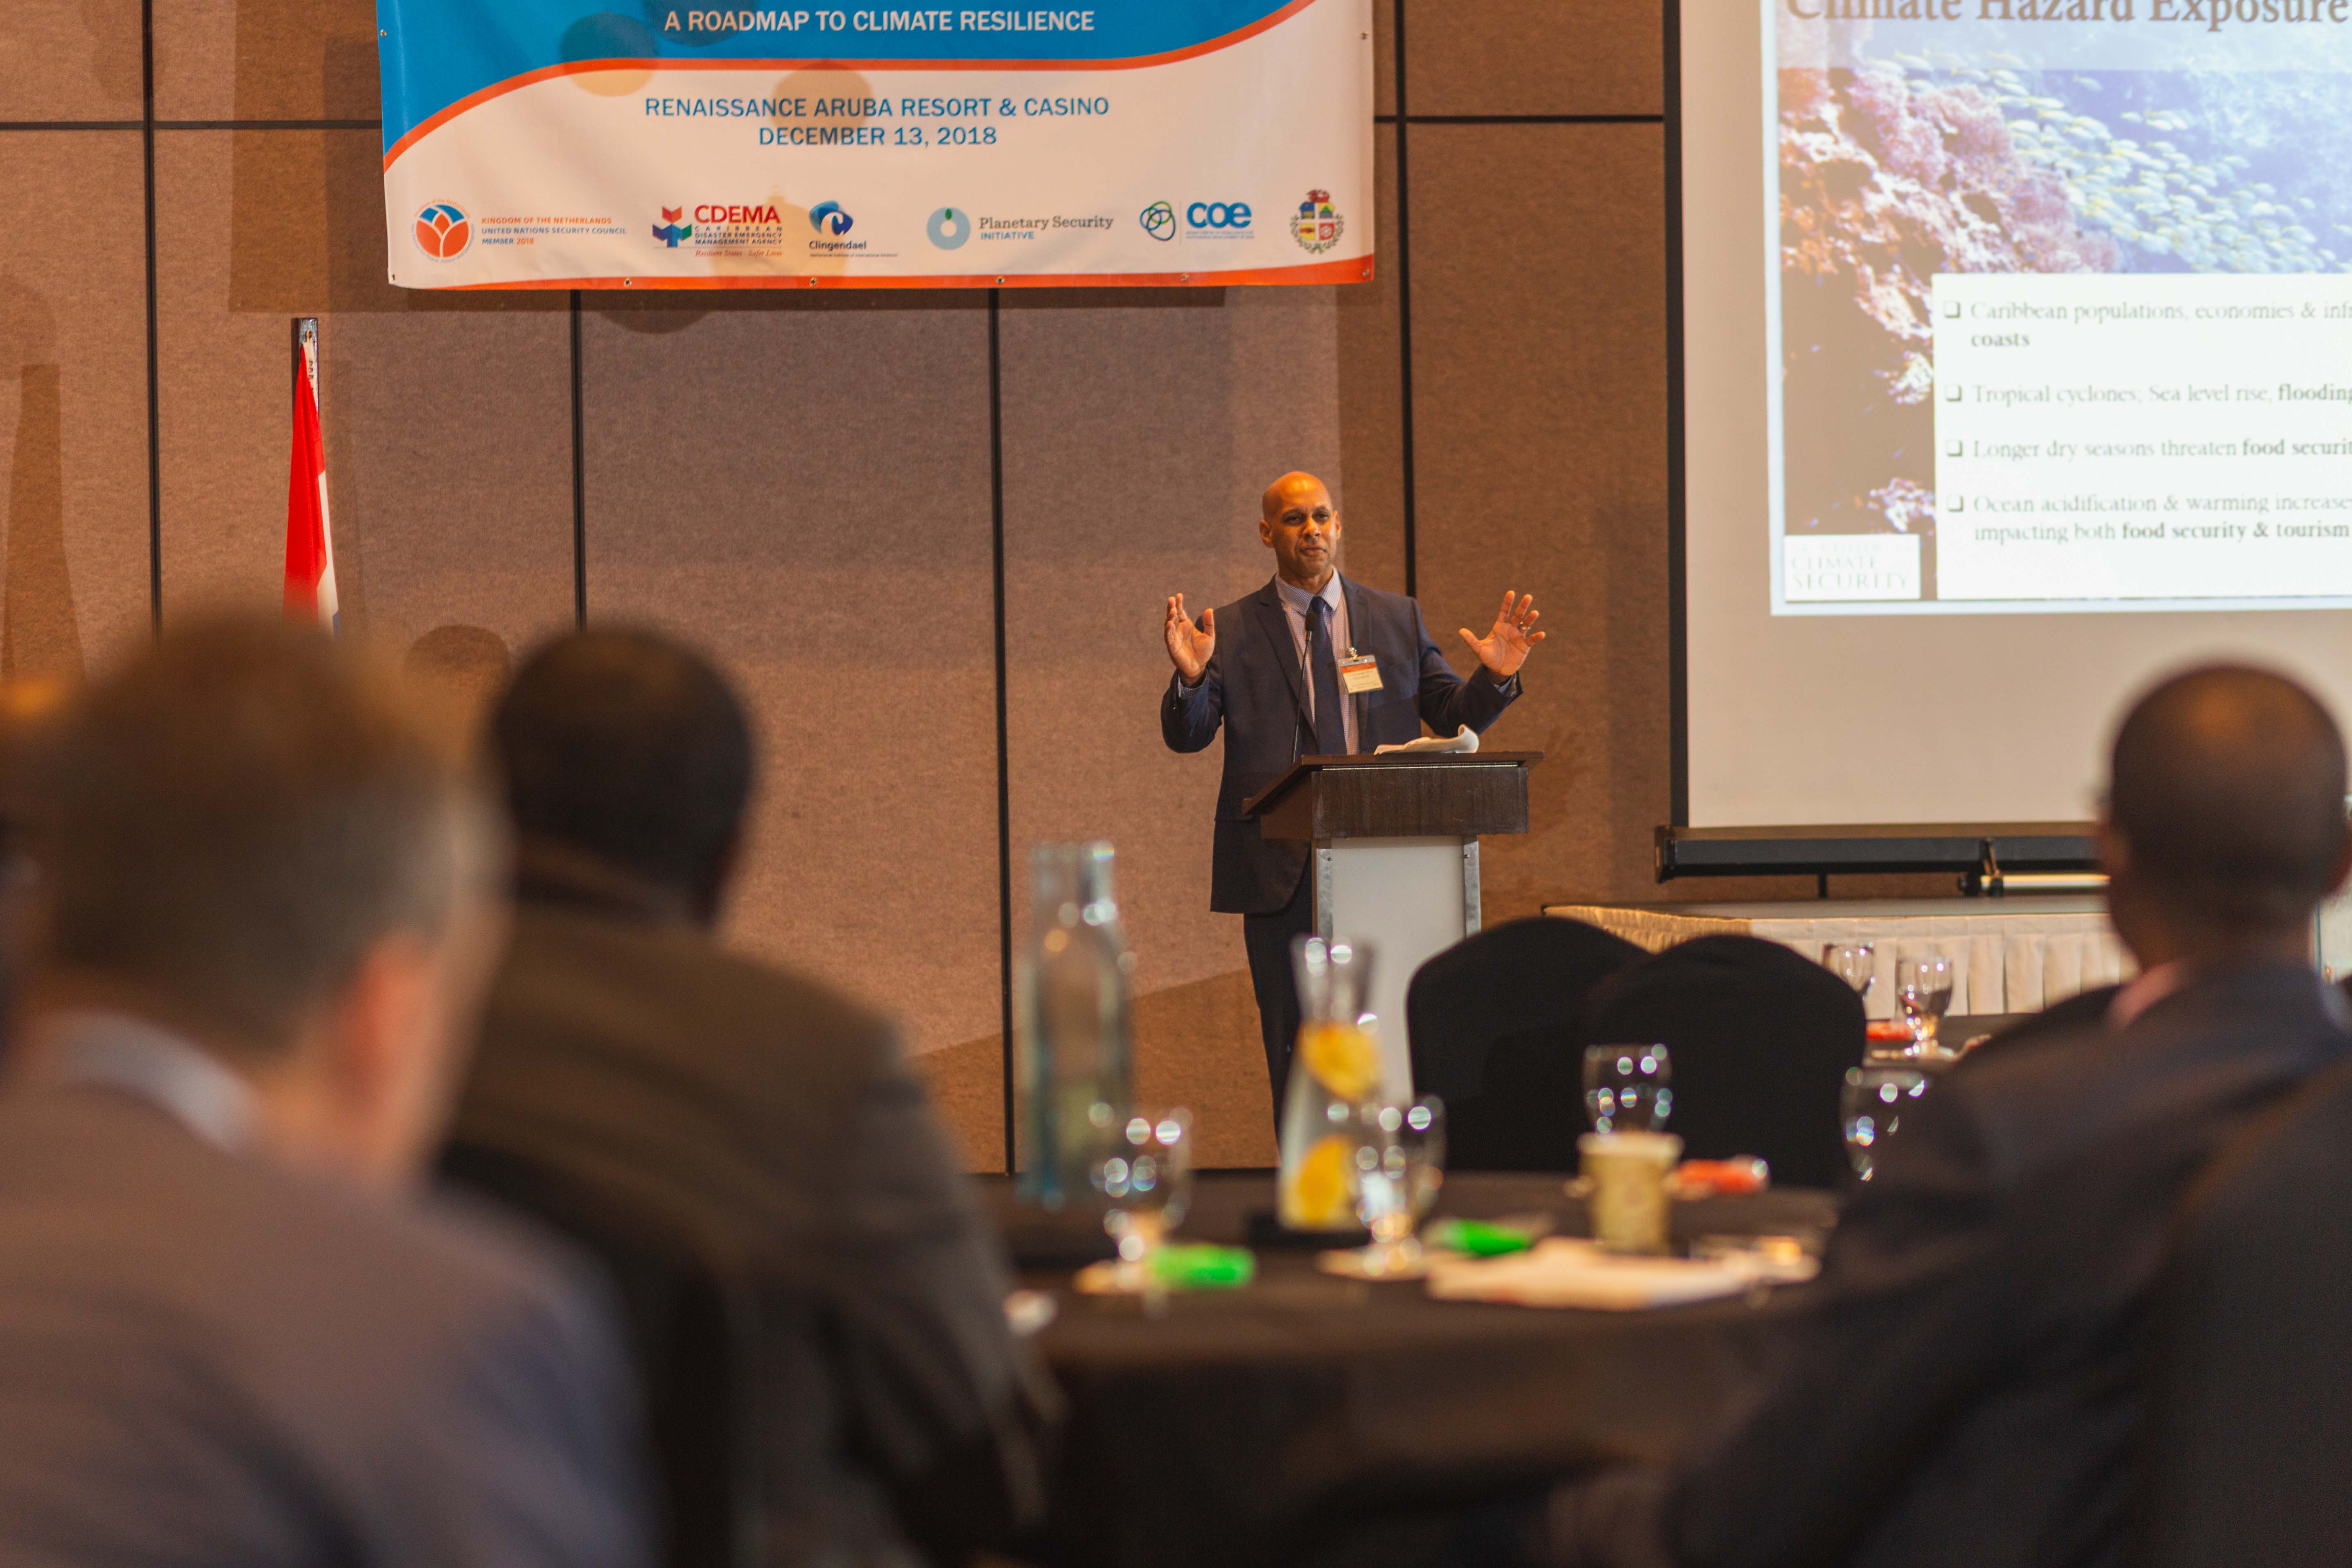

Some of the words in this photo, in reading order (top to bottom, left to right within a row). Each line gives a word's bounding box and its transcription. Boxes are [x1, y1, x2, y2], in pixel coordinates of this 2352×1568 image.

[664, 11, 681, 31] A
[688, 11, 810, 31] ROADMAP
[815, 11, 846, 31] TO
[853, 11, 953, 31] CLIMATE
[960, 11, 1095, 31] RESILIENCE
[1788, 0, 1962, 20] Climate
[1976, 0, 2135, 21] Hazard
[2149, 0, 2349, 32] Exposure
[646, 98, 807, 117] RENAISSANCE
[814, 98, 893, 117] ARUBA
[901, 98, 991, 117] RESORT
[999, 98, 1017, 117] &
[1024, 97, 1109, 116] CASINO
[759, 127, 885, 145] DECEMBER
[894, 126, 928, 148] 13,
[937, 126, 997, 145] 2018
[694, 205, 781, 224] CDEMA
[979, 217, 1049, 230] Planetary
[1052, 215, 1113, 230] Security
[1187, 202, 1252, 228] coe
[809, 240, 867, 251] Clingendael
[981, 231, 1034, 240] INITIATIVE
[1971, 302, 2068, 319] Caribbean
[2074, 302, 2189, 324] populations,
[2195, 302, 2294, 319] economies
[2300, 302, 2317, 319] &
[1971, 334, 2030, 347] coasts
[1973, 384, 2050, 407] Tropical
[2149, 384, 2181, 401] Sea
[2188, 384, 2229, 402] level
[1973, 440, 2040, 462] Longer
[2046, 440, 2077, 462] dry
[2085, 443, 2155, 457] seasons
[2161, 440, 2237, 456] threaten
[2242, 439, 2285, 456] food
[1973, 496, 2034, 512] Ocean
[2041, 494, 2157, 512] acidification
[2164, 494, 2179, 511] &
[2187, 493, 2269, 514] warming
[2276, 492, 2352, 510] increase
[1975, 523, 2068, 545] impacting
[2074, 523, 2116, 539] both
[2123, 521, 2165, 538] food
[2172, 520, 2246, 543] security
[2253, 521, 2269, 537] &
[2277, 519, 2350, 537] tourism
[1793, 573, 1910, 589] SECURITY
